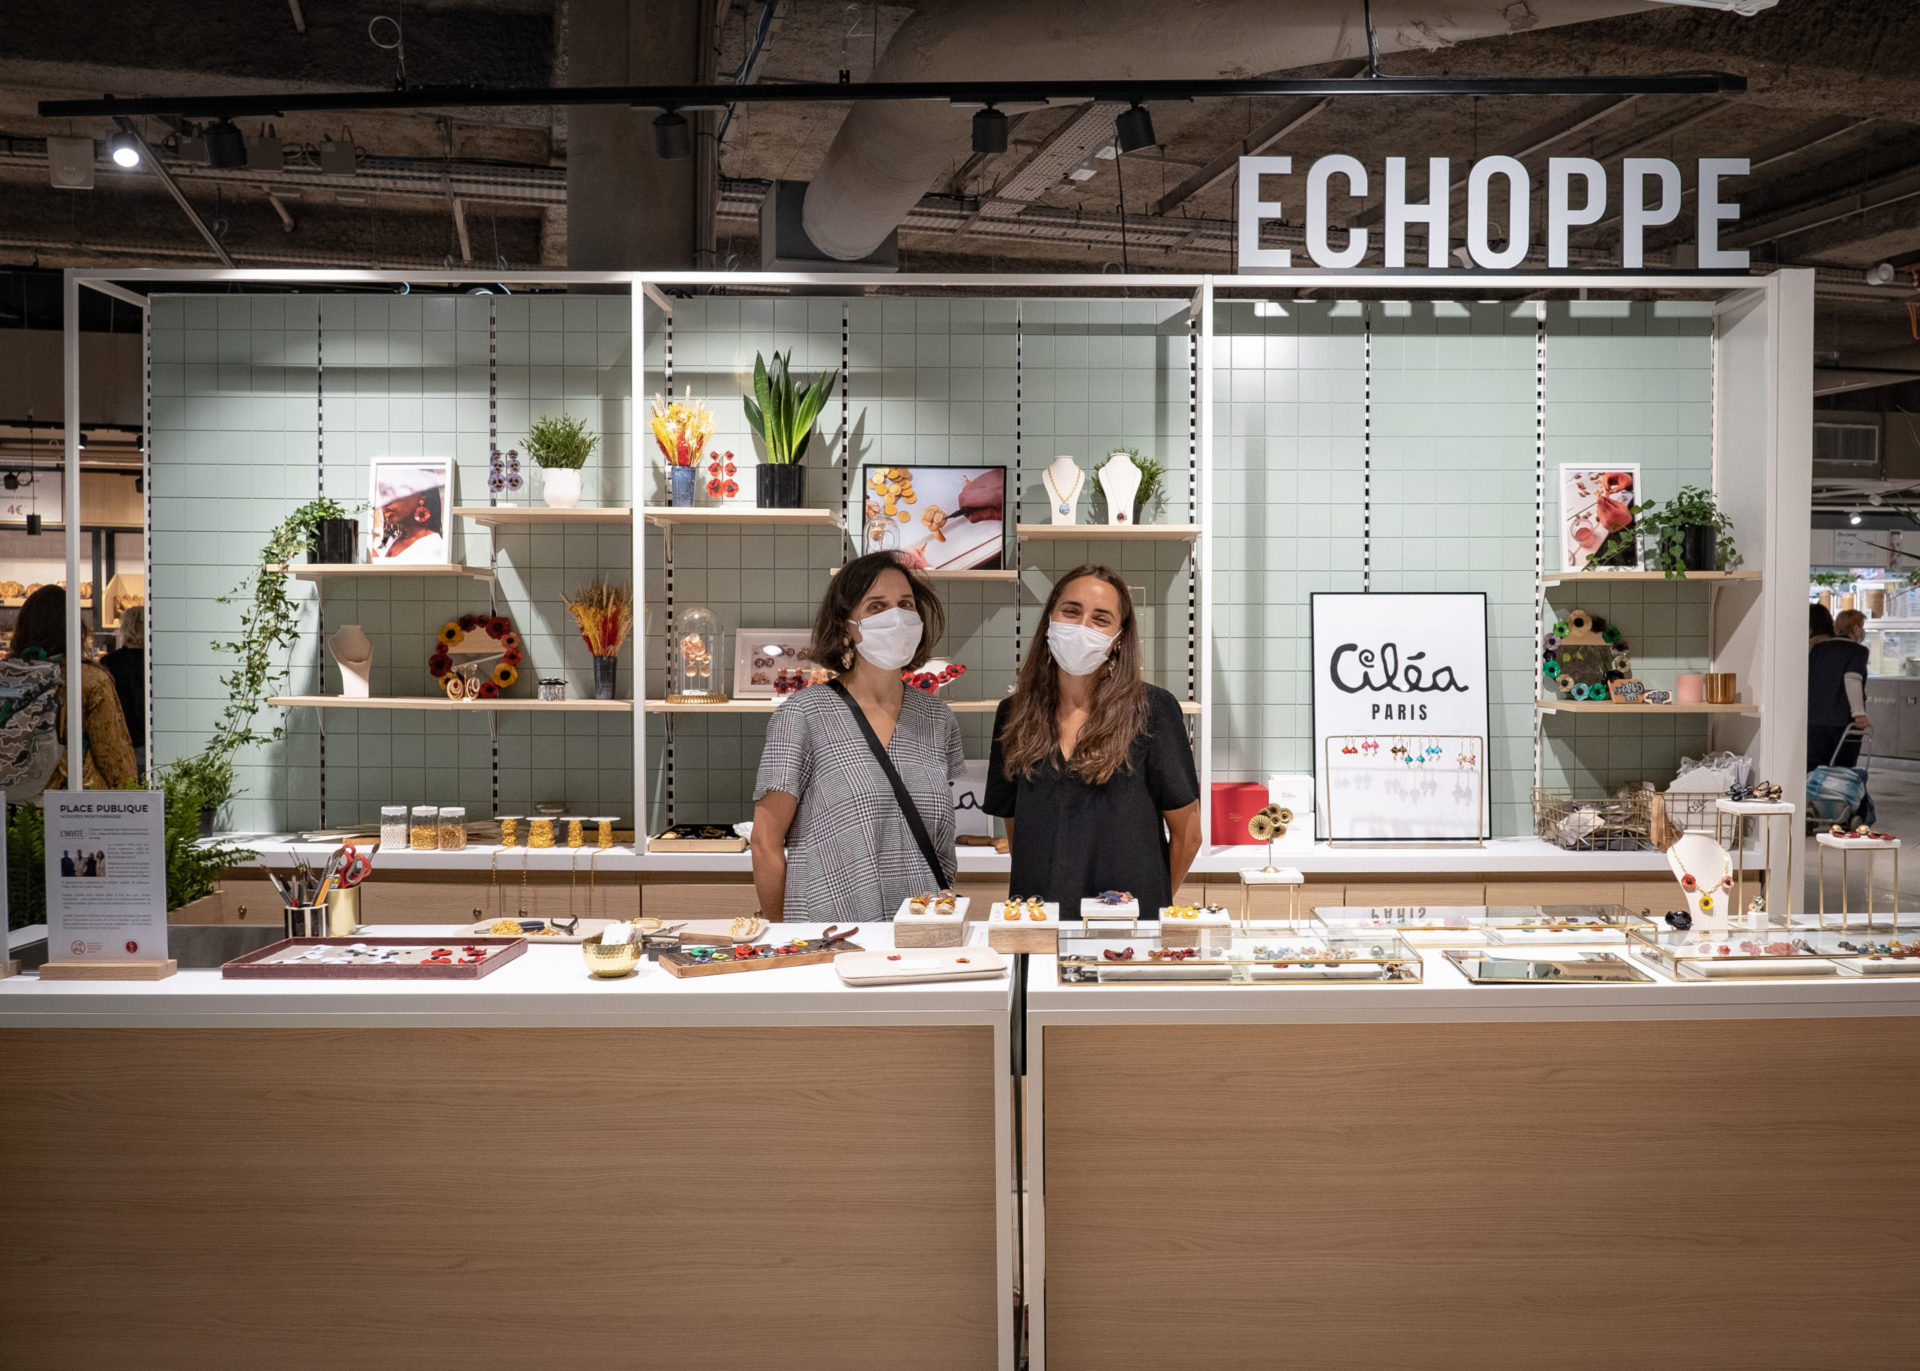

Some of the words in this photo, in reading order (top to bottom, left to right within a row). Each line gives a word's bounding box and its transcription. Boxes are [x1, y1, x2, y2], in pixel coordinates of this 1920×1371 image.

[1238, 154, 1750, 269] ECHOPPE
[7, 504, 23, 515] 4€
[1330, 643, 1469, 693] Ciléa
[1371, 704, 1428, 720] PARIS
[60, 804, 93, 813] PLACE
[96, 804, 149, 814] PUBLIQUE
